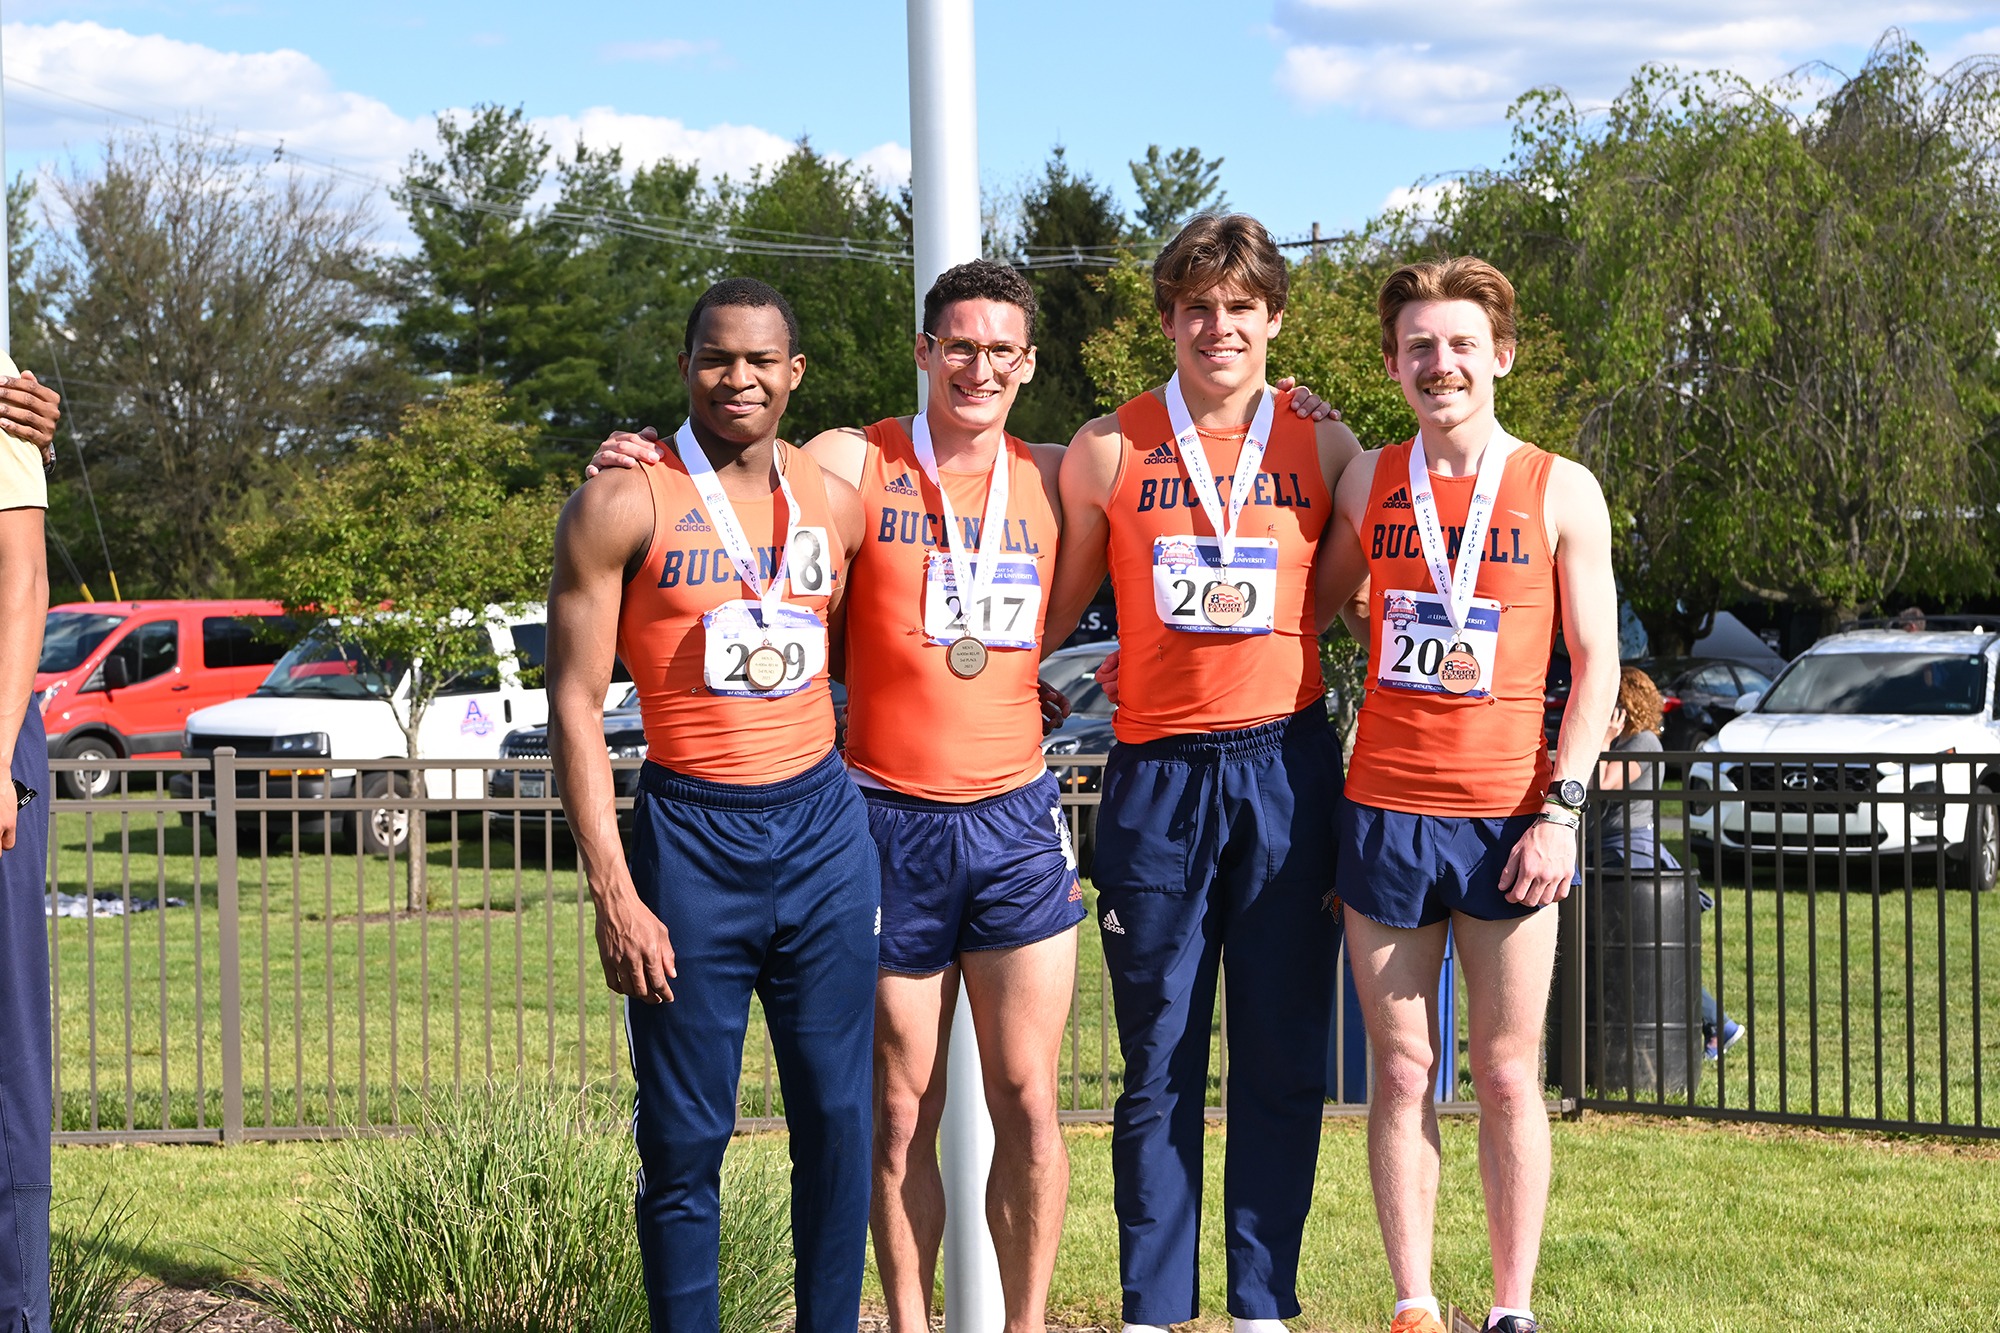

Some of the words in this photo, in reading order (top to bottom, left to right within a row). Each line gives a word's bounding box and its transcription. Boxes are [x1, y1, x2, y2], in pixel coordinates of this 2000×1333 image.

[1144, 454, 1179, 465] adidas
[884, 484, 918, 497] adidas
[1137, 472, 1311, 513] BUCKELL
[1382, 500, 1412, 510] adidas
[675, 523, 712, 533] adidas
[878, 507, 1039, 555] BUCNLL
[1371, 523, 1529, 565] BUCNLL
[1468, 510, 1482, 555] PATRIOT
[658, 546, 837, 588] BUCN
[793, 530, 823, 592] 8
[1423, 508, 1437, 549] PATRIOT
[1434, 557, 1448, 595] LEAGUE
[945, 595, 1025, 632] 217
[724, 642, 805, 681] 29
[1102, 921, 1126, 935] adidas
